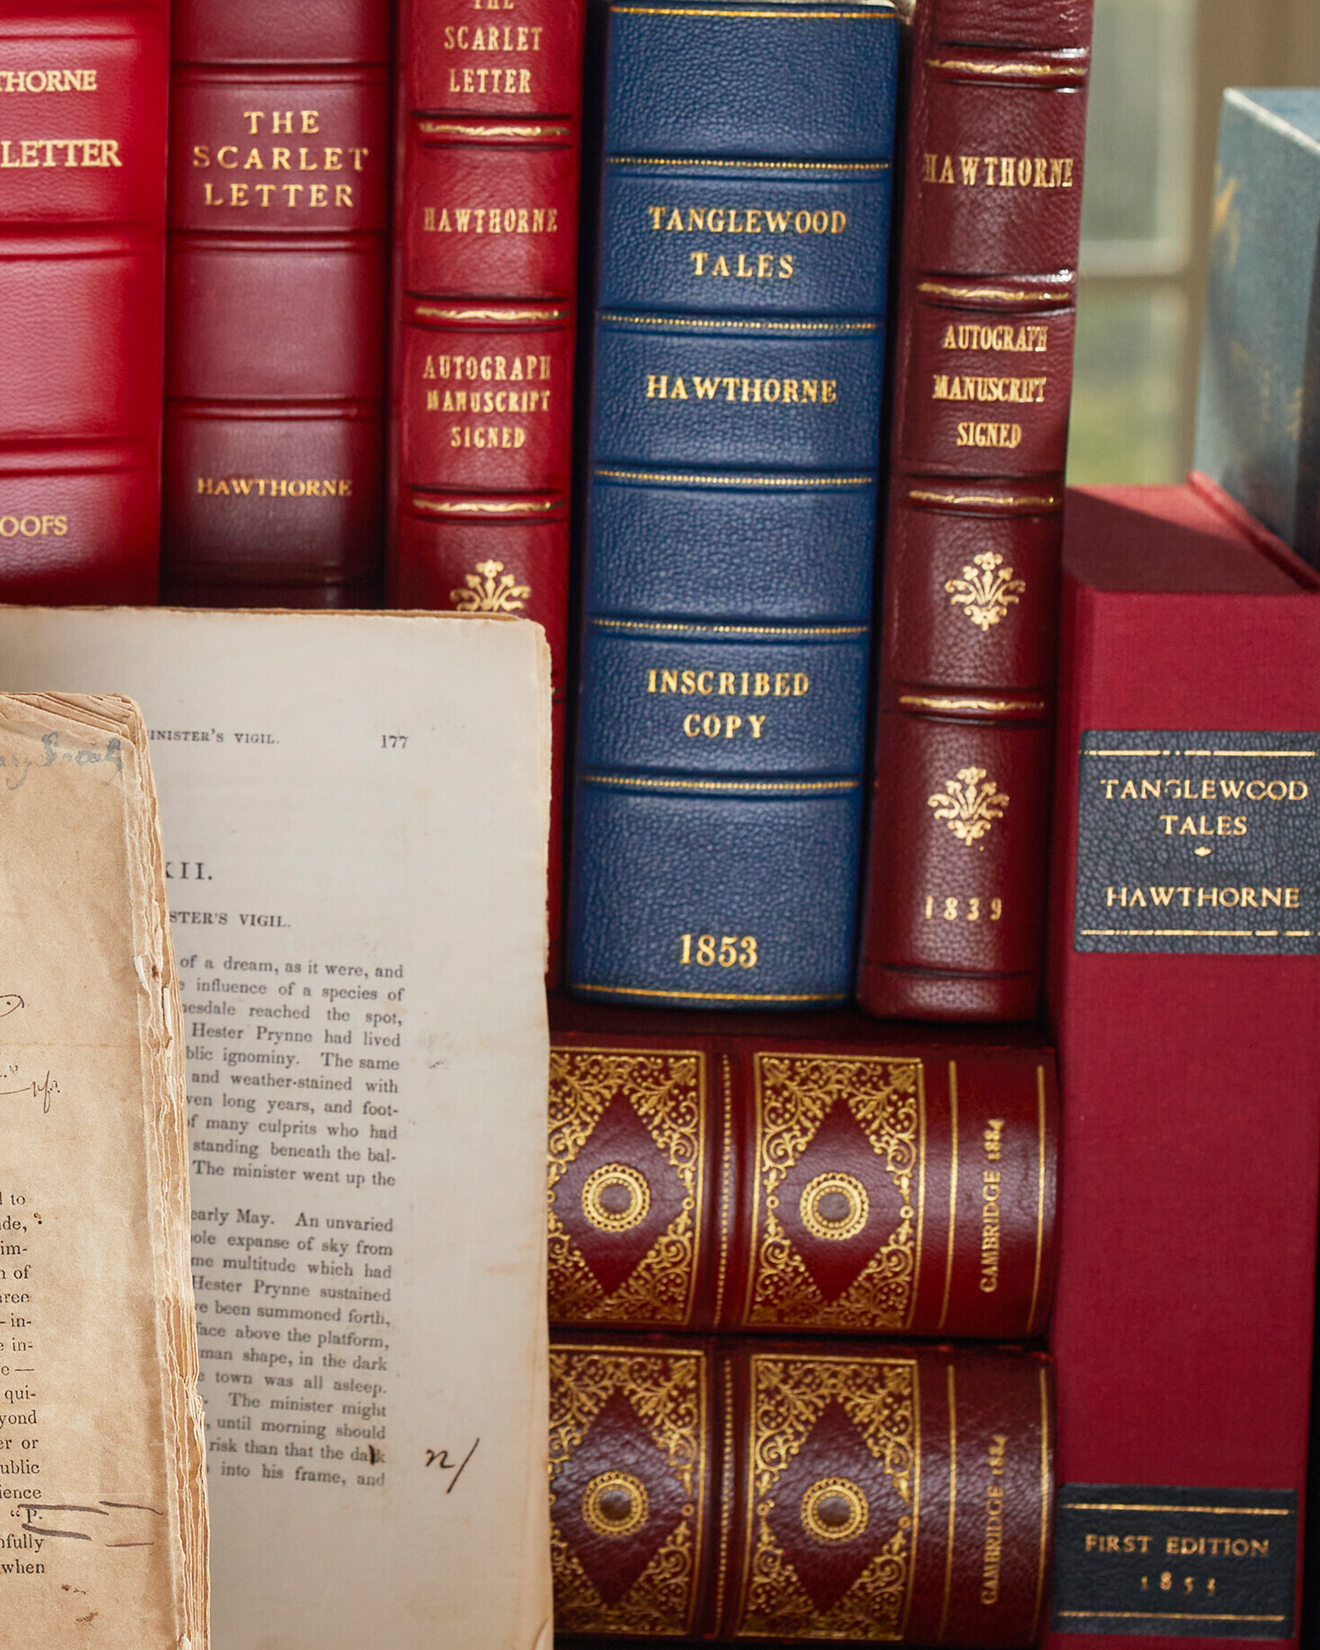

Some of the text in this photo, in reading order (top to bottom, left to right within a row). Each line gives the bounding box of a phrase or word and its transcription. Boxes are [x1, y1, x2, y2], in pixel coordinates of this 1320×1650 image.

[445, 26, 541, 51] SCARLET
[450, 69, 531, 94] LETTER
[244, 111, 319, 134] THE
[0, 139, 122, 168] LETTER
[193, 147, 368, 170] SCARLET
[926, 154, 1073, 188] HAWTHORNE
[205, 183, 352, 207] LETTER
[425, 208, 557, 234] HAWTHORNE
[649, 206, 846, 234] TANGLEWOOD
[691, 252, 793, 278] TALES
[944, 325, 1048, 352] AUTOGRAPH
[424, 356, 550, 381] AUTOGRAPH
[647, 375, 836, 403] HAWTHORNE
[933, 375, 1046, 402] MANUSCRIPT
[427, 390, 550, 413] MANUSCRIPT
[451, 427, 525, 448] SIGNED
[957, 421, 1021, 448] SIGNED
[197, 477, 353, 497] HAWTHORNE
[648, 669, 809, 696] INSCRIBED
[146, 727, 281, 746] INISTER’S VIGIL.
[684, 714, 766, 738] COPY
[380, 733, 410, 750] 177
[1100, 779, 1309, 801] TANGLEWOOD
[1160, 815, 1247, 836] TALES
[1106, 886, 1300, 908] HAWTHORNE
[239, 913, 292, 929] VIGIL.
[680, 934, 757, 968] 1853
[192, 1137, 397, 1164] standing beneath the bal-
[191, 1158, 396, 1189] The minister went up the
[980, 1119, 1005, 1293] CAMBRIDGE 1884
[21, 1438, 39, 1450] or
[220, 1460, 386, 1487] into his frame, and
[982, 1485, 1004, 1605] CAMBRIDGE
[1086, 1534, 1269, 1556] FIRST EDITION
[0, 1558, 46, 1574] when
